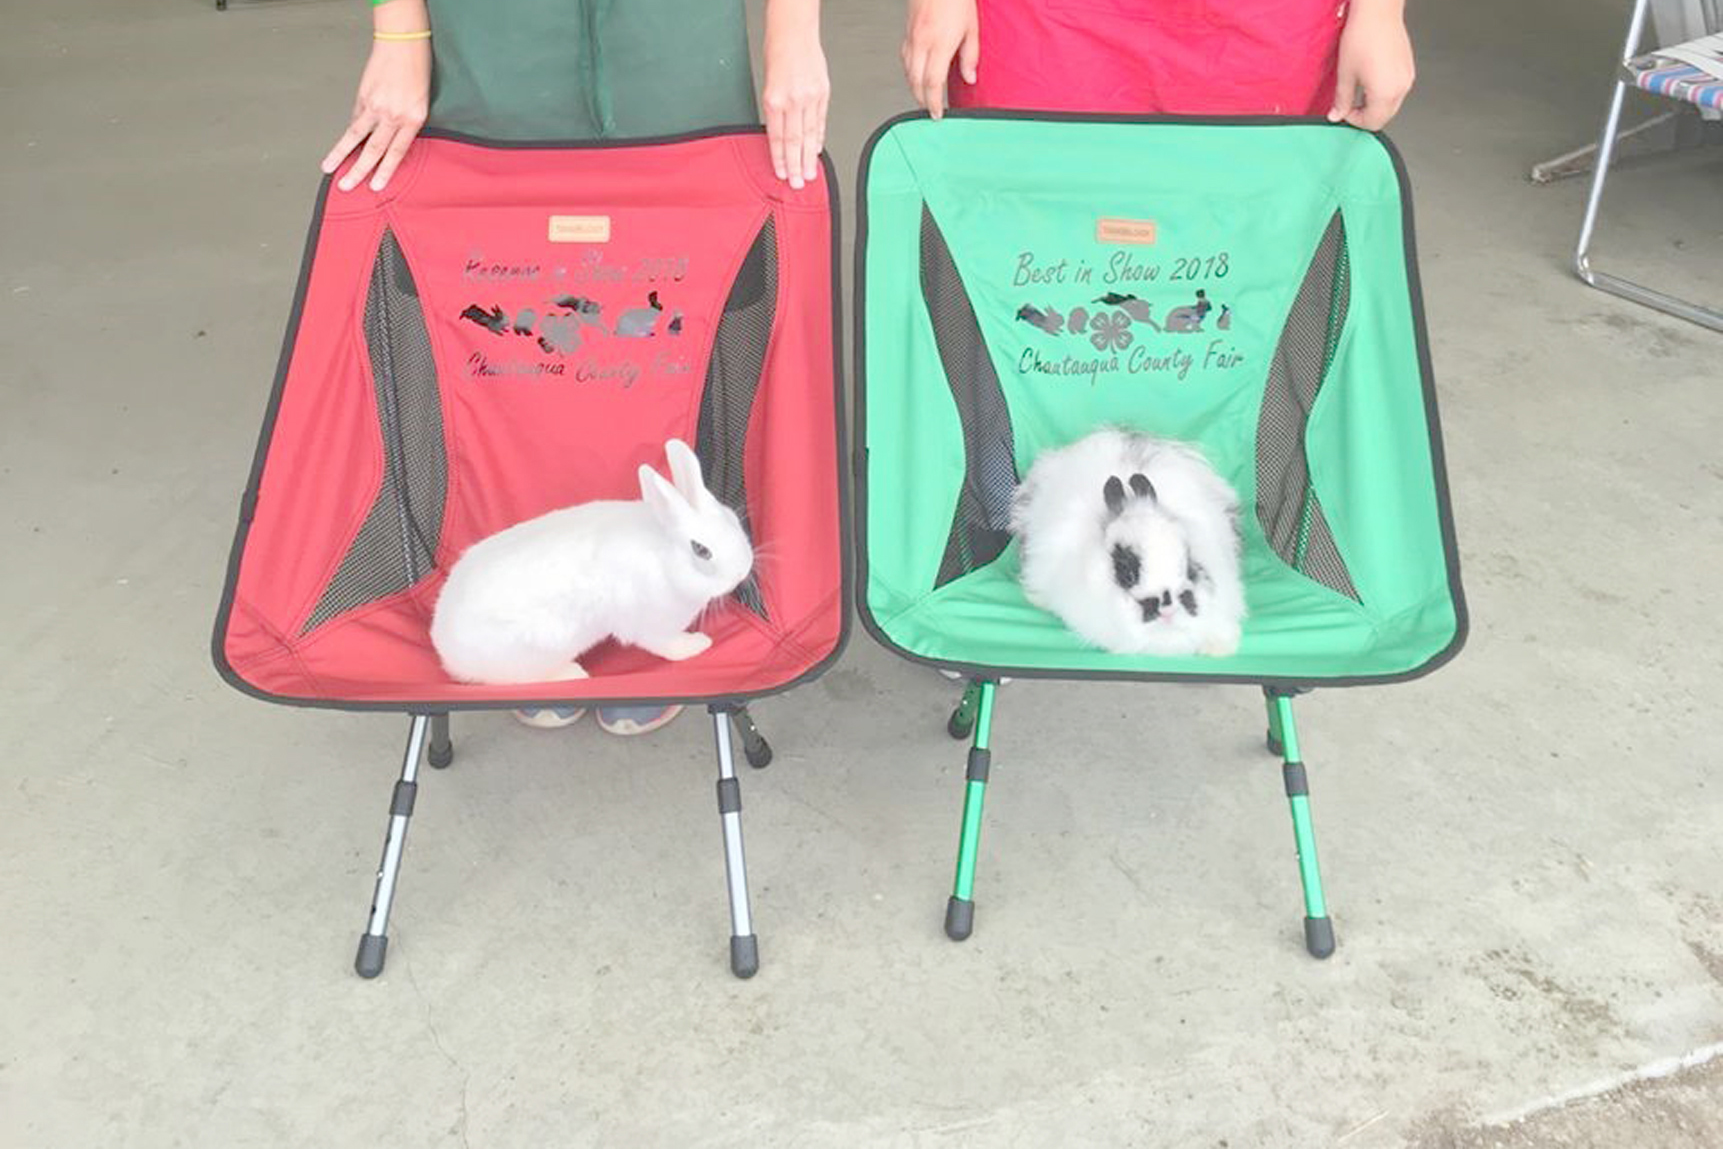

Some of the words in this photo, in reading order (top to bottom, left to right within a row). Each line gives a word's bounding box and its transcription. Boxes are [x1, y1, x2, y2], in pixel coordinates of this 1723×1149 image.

[1013, 252, 1067, 286] Best
[1074, 260, 1092, 284] in
[1103, 251, 1160, 284] Show
[1170, 252, 1230, 281] 2018
[1018, 347, 1119, 386] Chautauqua
[1128, 345, 1193, 380] County
[1203, 339, 1244, 369] Fair
